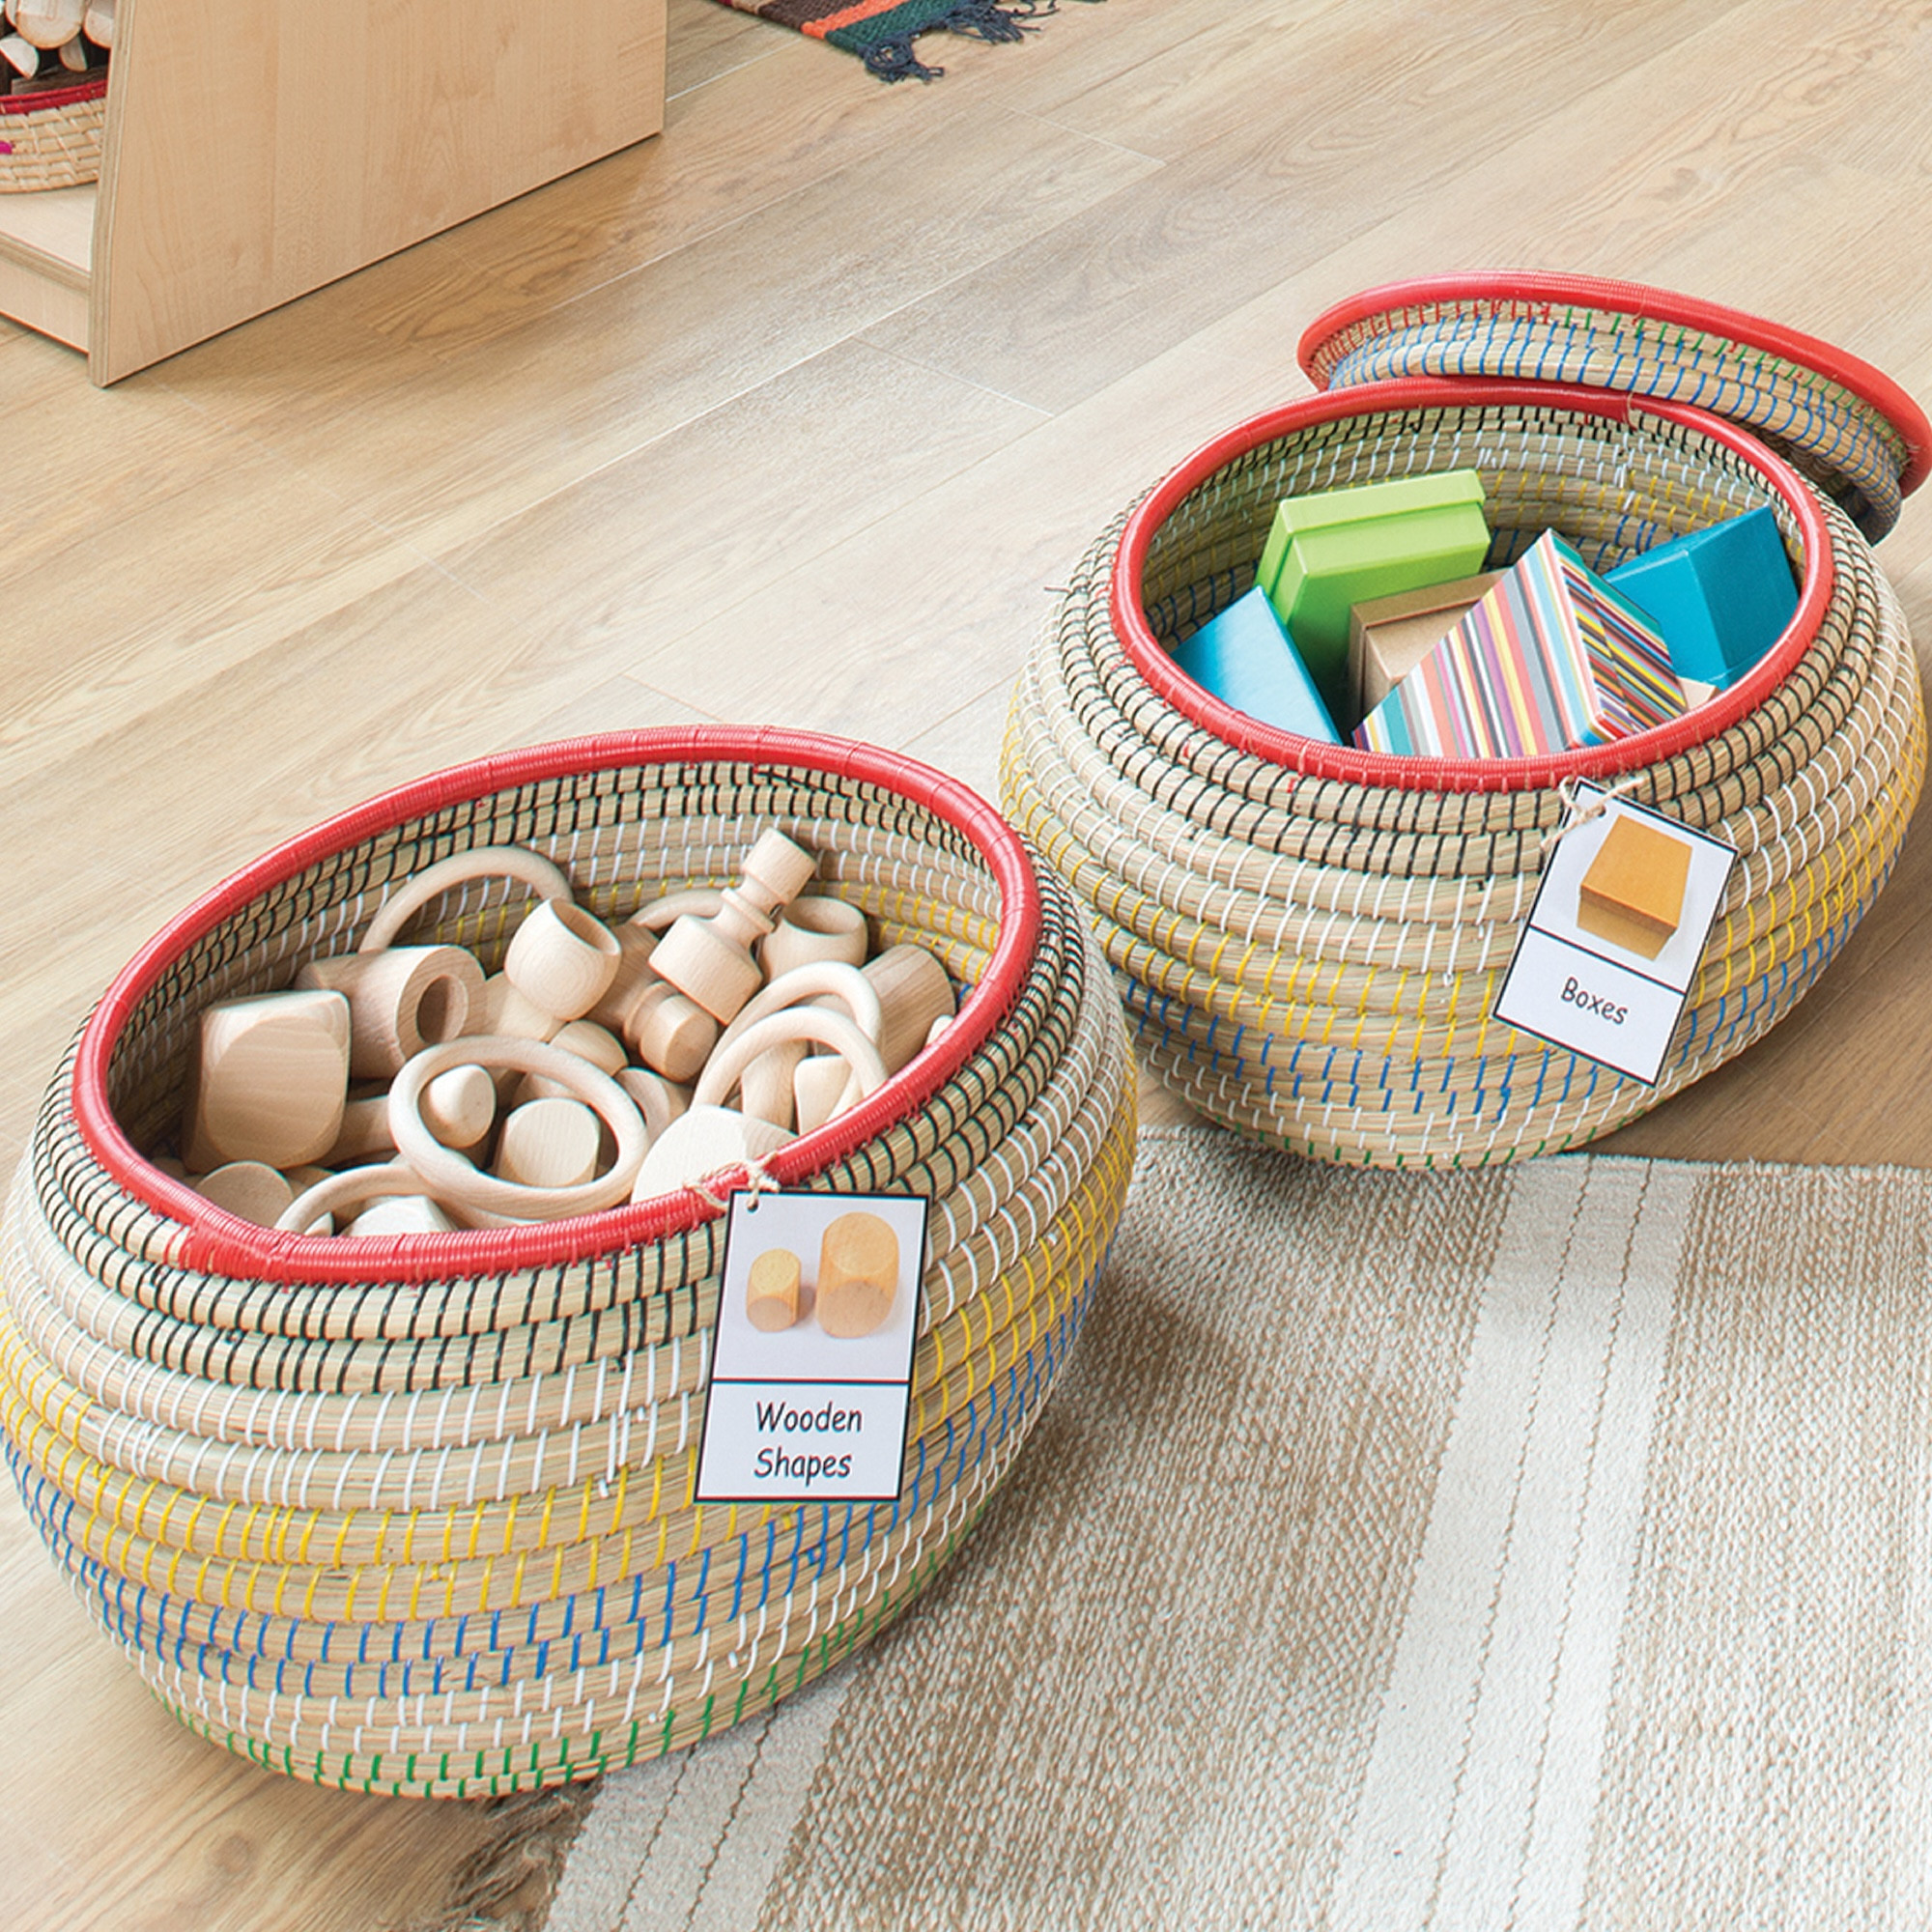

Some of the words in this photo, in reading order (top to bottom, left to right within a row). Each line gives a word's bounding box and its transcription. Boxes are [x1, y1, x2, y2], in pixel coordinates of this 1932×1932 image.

[1560, 976, 1629, 1025] Boxes
[756, 1401, 863, 1433] Wooden
[754, 1446, 852, 1487] Shapes
